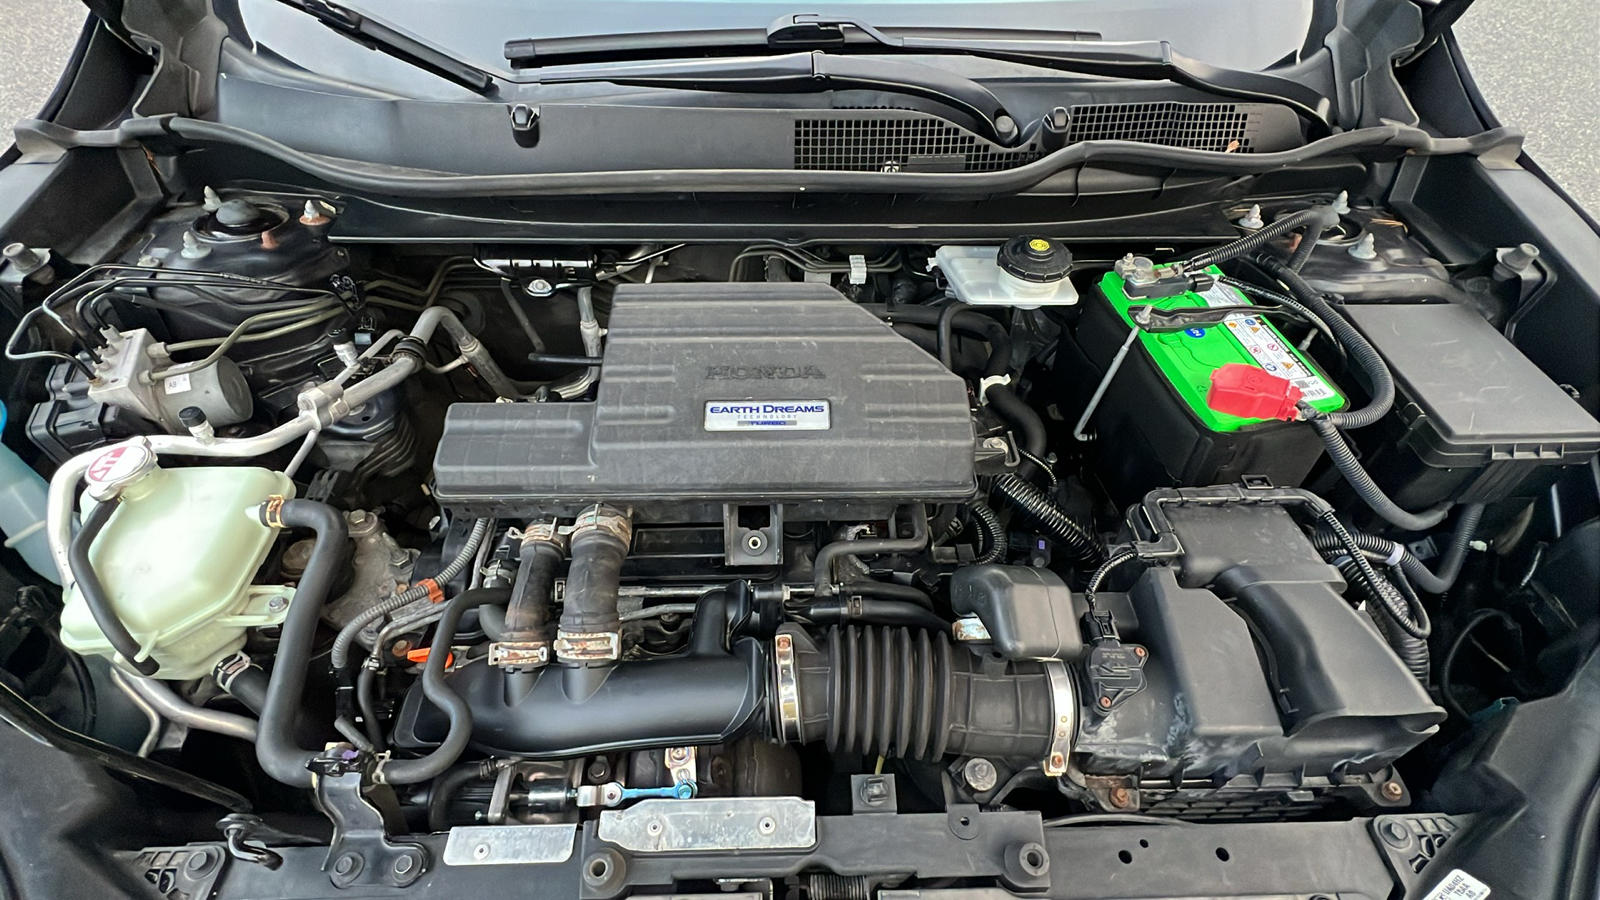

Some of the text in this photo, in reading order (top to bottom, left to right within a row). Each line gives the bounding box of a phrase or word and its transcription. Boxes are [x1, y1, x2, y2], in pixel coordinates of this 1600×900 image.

[705, 365, 826, 380] HONDA
[710, 404, 825, 414] EARTH DREAMS
